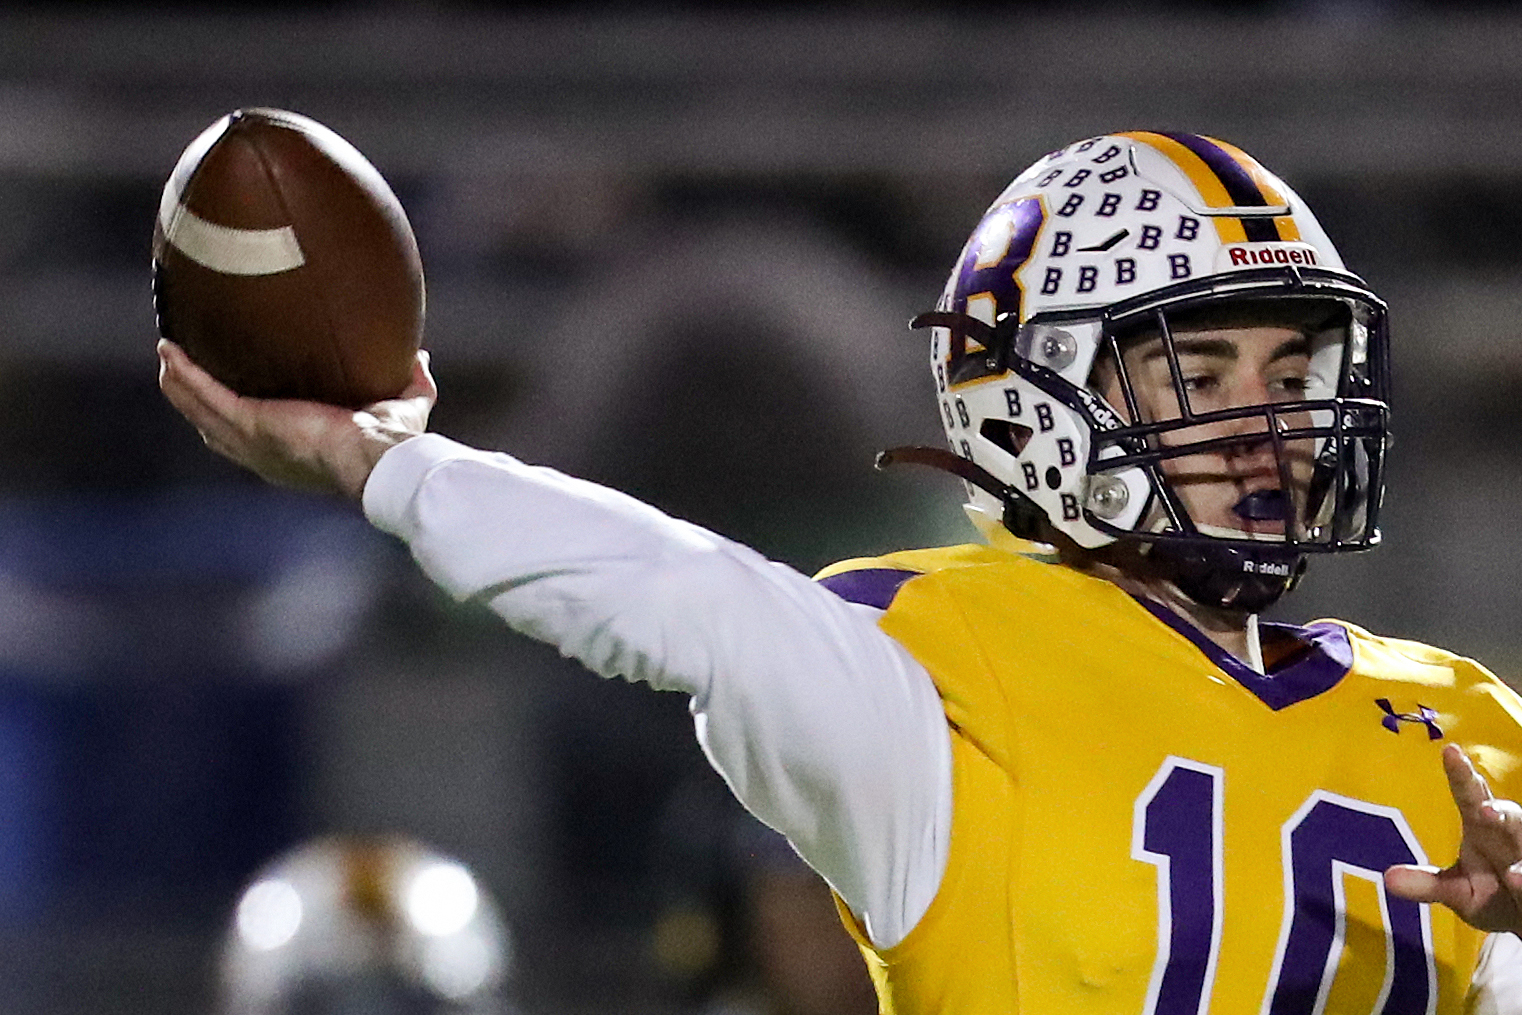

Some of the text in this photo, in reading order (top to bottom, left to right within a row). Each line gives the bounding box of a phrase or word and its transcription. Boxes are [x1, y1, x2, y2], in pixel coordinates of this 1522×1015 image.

[1091, 145, 1121, 164] B
[1063, 169, 1091, 187] B
[1099, 164, 1128, 184] B
[1056, 193, 1085, 217] B
[1094, 193, 1121, 217] B
[1134, 189, 1161, 211] B
[1136, 225, 1162, 250] B
[1175, 215, 1200, 241] B
[1050, 231, 1072, 258] B
[1229, 247, 1317, 266] Riddell
[1076, 266, 1099, 293] B
[1115, 257, 1136, 285] B
[1168, 254, 1192, 280] B
[1041, 267, 1063, 295] B
[1004, 388, 1022, 417] B
[1035, 403, 1054, 433] B
[1057, 438, 1077, 467] B
[1021, 462, 1039, 491] B
[1061, 493, 1080, 522] B
